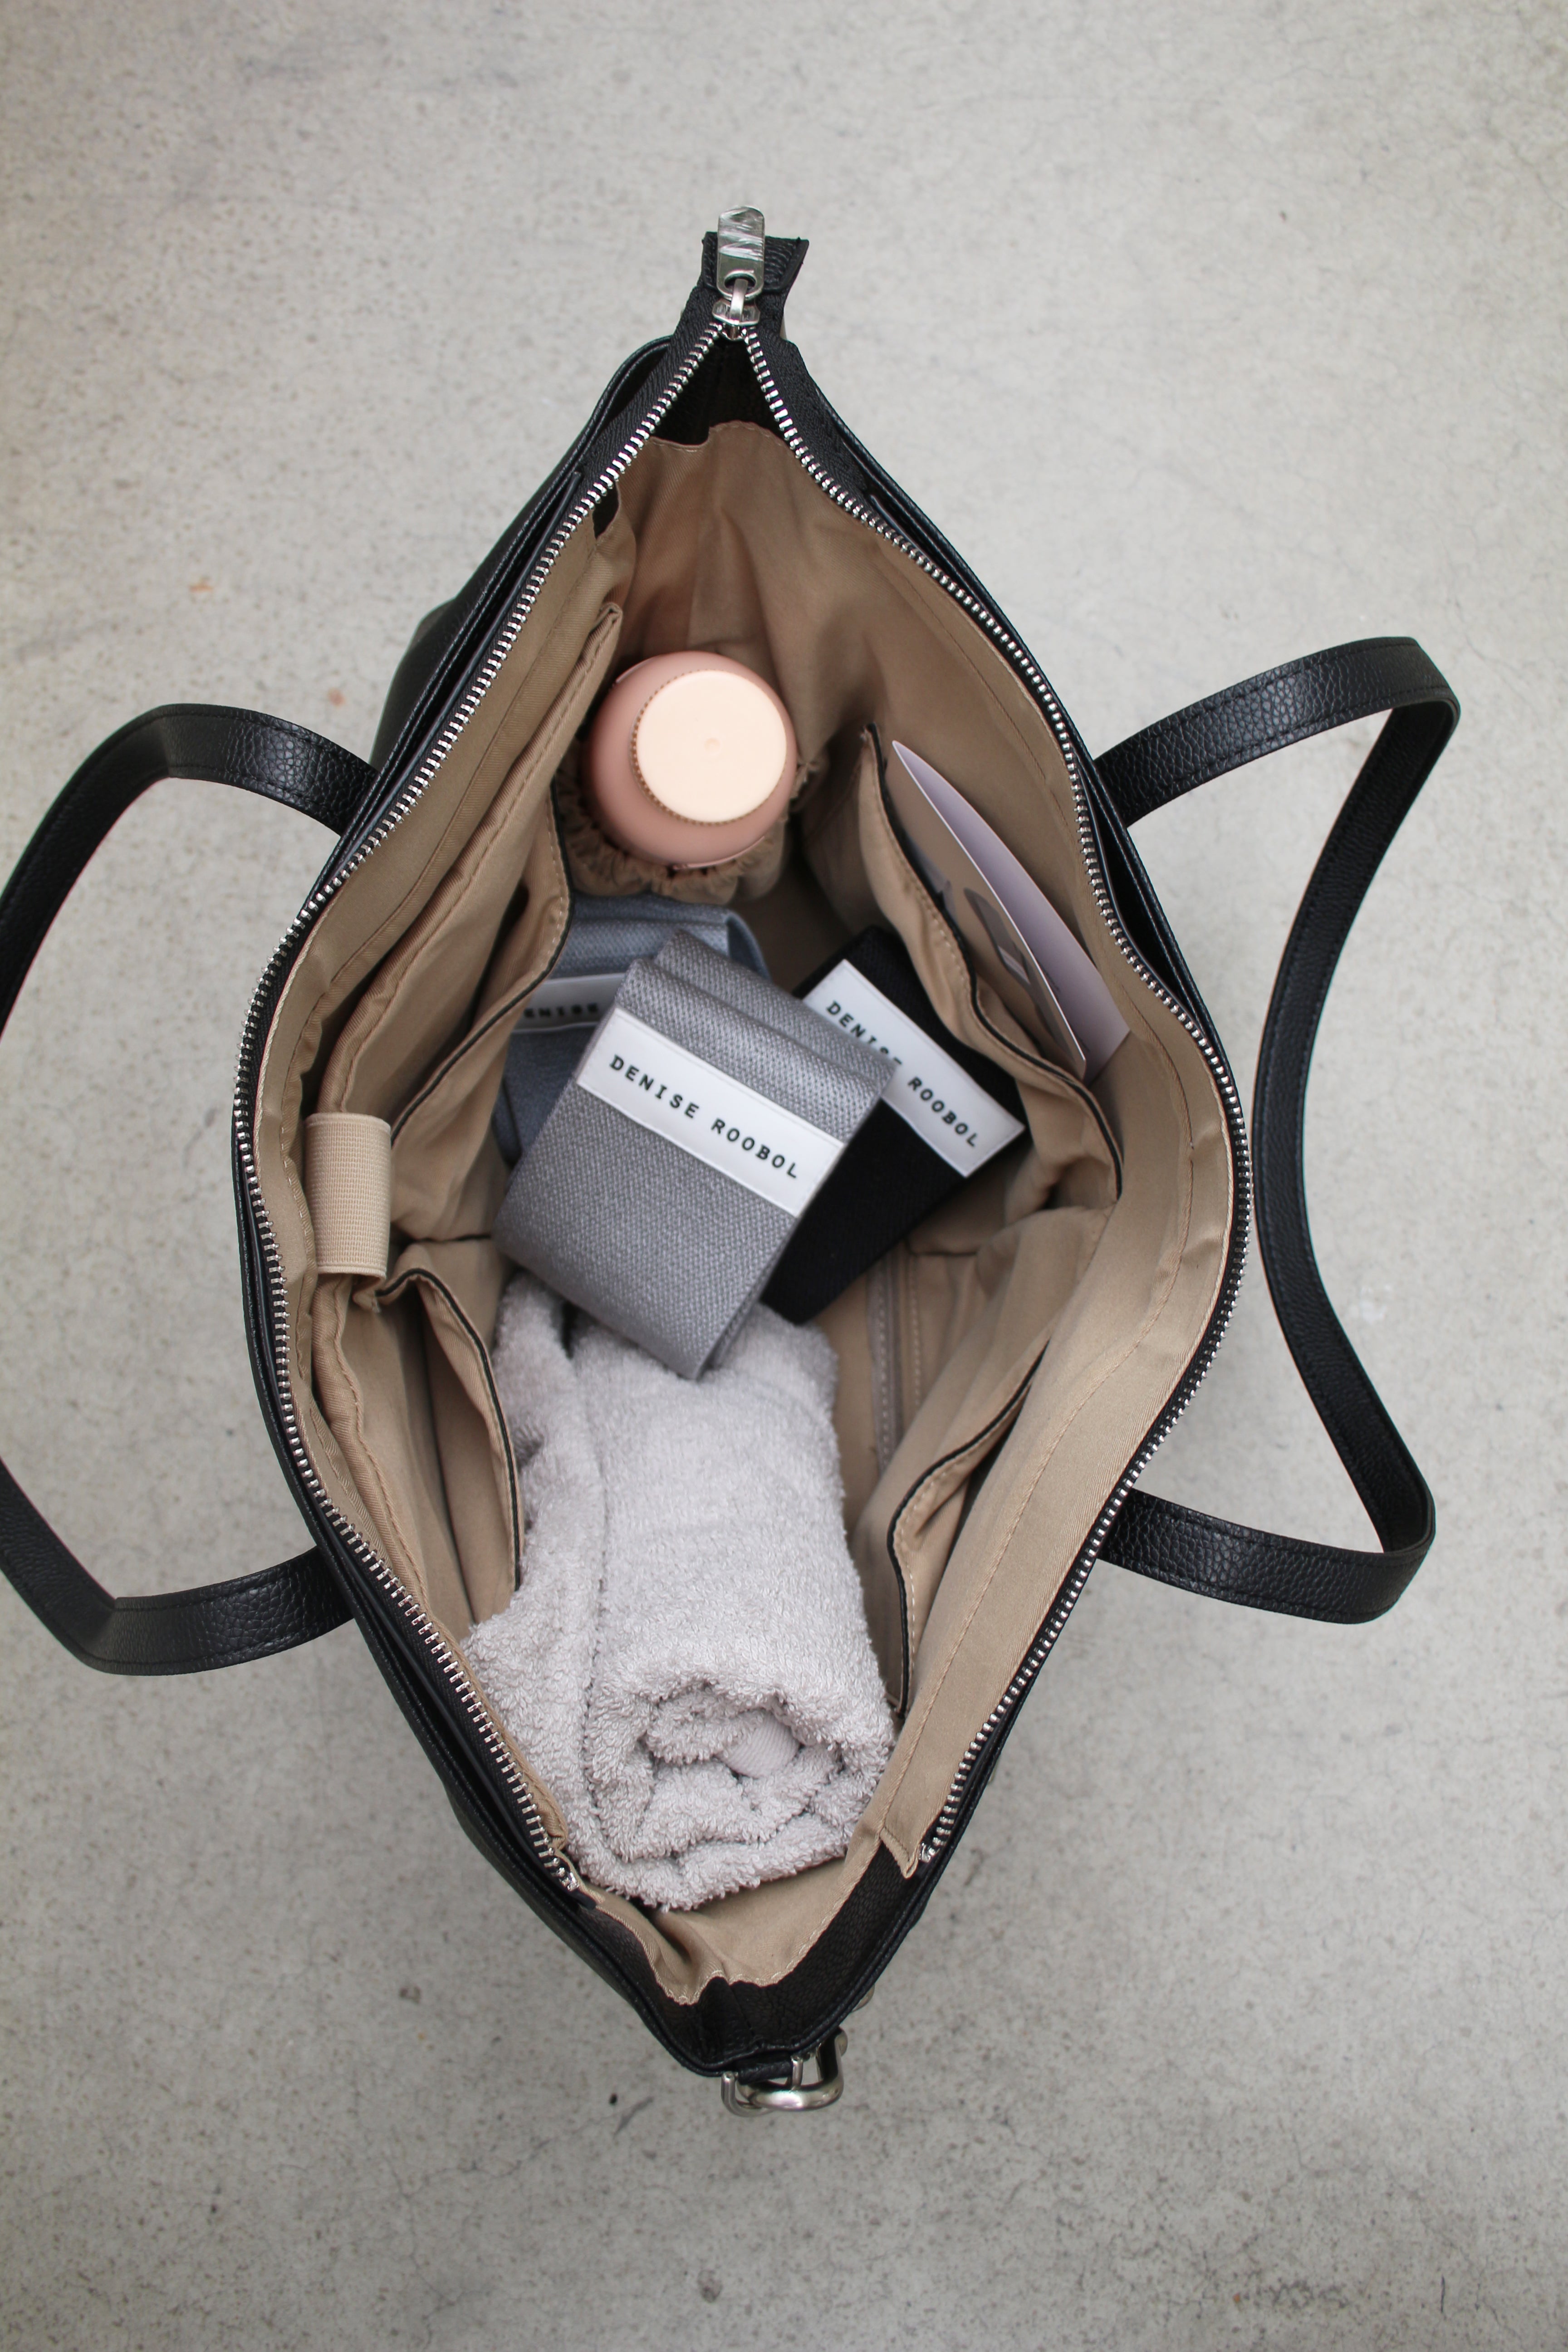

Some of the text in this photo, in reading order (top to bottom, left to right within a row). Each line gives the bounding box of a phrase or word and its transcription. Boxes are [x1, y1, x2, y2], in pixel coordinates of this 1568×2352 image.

[609, 1054, 797, 1179] DENISE ROOBOL
[826, 1000, 976, 1147] DENI ROOBOL
